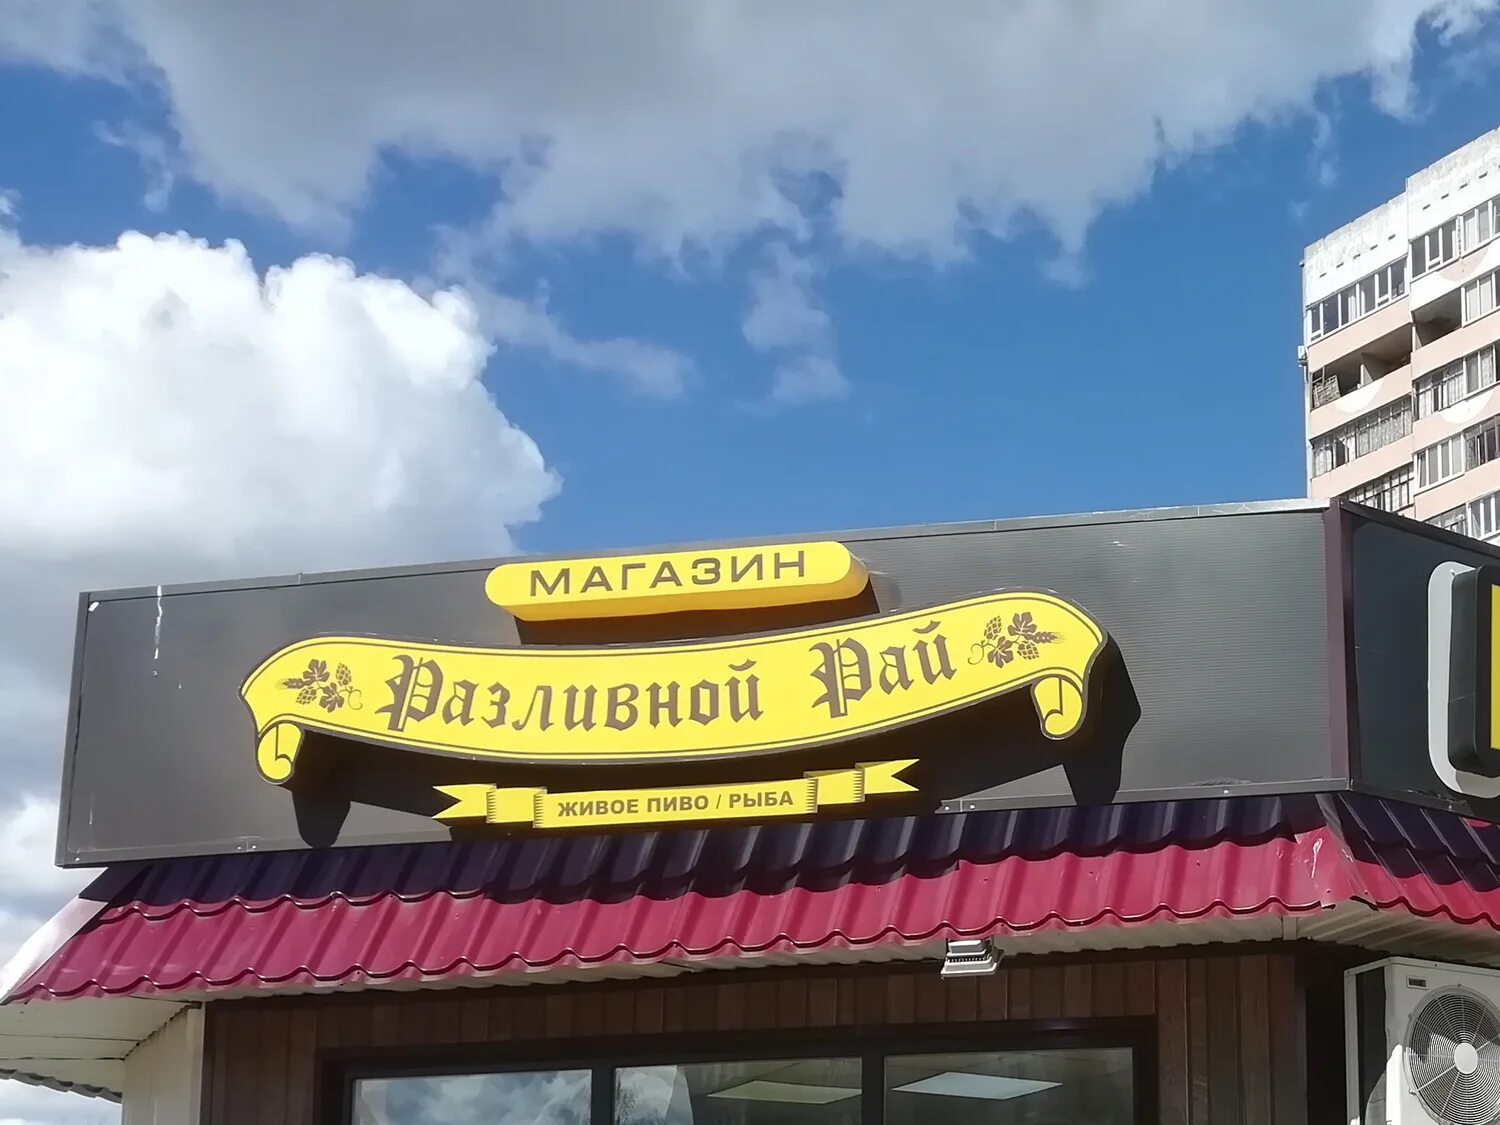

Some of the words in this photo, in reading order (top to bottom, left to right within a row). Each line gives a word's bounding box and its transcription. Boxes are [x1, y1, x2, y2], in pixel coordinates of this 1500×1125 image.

[528, 548, 807, 597] МАГАЗИН
[374, 653, 763, 733] Разливной
[808, 619, 958, 719] Рай
[557, 799, 639, 818] ЖИВОЕ
[646, 794, 709, 813] ПИВО
[728, 790, 794, 809] РЫБА
